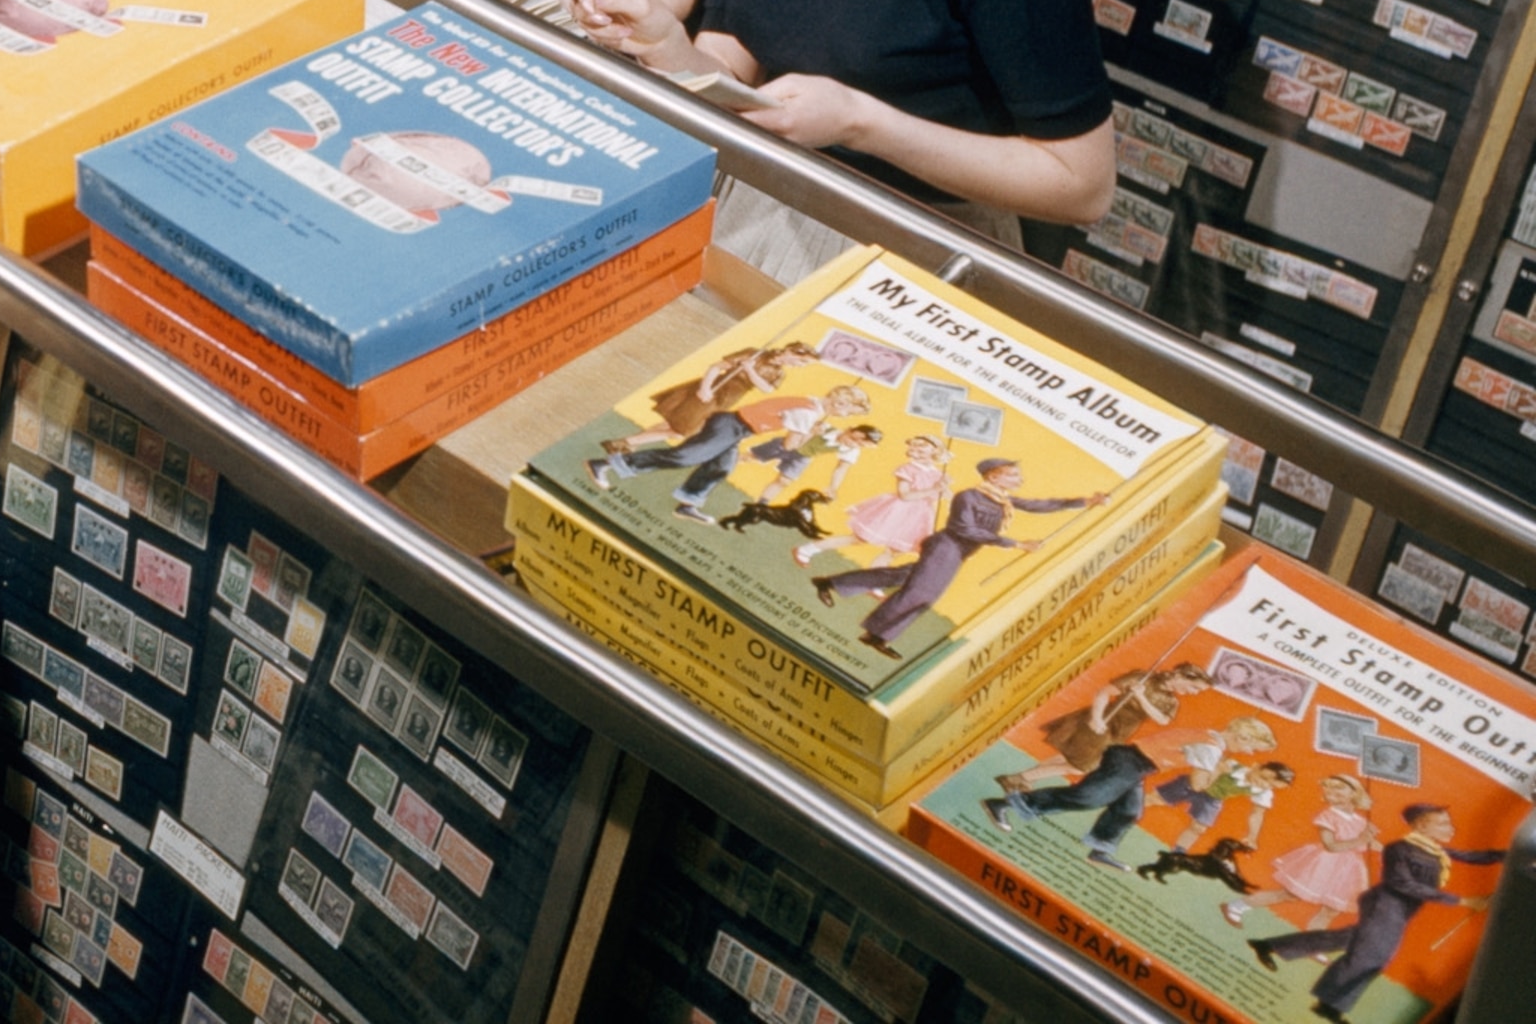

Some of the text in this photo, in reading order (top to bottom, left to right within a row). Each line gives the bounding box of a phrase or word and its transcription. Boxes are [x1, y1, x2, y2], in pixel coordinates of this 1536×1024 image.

[307, 52, 403, 104] OUTFIT
[346, 36, 585, 167] STAMP COLLECTOR'S
[387, 19, 659, 171] The New INTERNATIONAL
[449, 209, 638, 317] STAMP COLLECTOR'S OUTFIT
[464, 247, 642, 357] FIRST STAMP OUTFIT
[145, 312, 323, 438] FIRST STAMP OUTFIT
[447, 300, 619, 410] FIRST STAMP OUTFIT
[846, 296, 1137, 460] THE IDEAL ALBUM FOR THE BEGINNING COLLECTOR
[869, 277, 1162, 445] My First Stamp Album
[547, 512, 836, 703] MY FIRST STAMP OUTFIT
[776, 595, 812, 621] 2500
[965, 539, 1169, 716] MY FIRST STAMP OUTFIT
[966, 495, 1169, 677] MY FIRST STAMP OUTFIT
[686, 629, 709, 650] Flags
[734, 658, 761, 683] Coats
[764, 678, 775, 691] of
[779, 688, 804, 710] Arms
[830, 717, 864, 746] Hinges
[826, 640, 870, 670] COUNTRY
[1249, 598, 1536, 765] First Stamp Out
[1257, 632, 1529, 783] A COMPLETE OUTFIT FOR THE BEGINNER
[1346, 631, 1504, 718] DELUXE EDITION
[685, 665, 709, 689] Flags
[733, 696, 759, 722] Coats
[762, 719, 773, 730] of
[776, 726, 800, 749] Arms
[825, 755, 859, 785] Hinges
[72, 802, 94, 824] HAITI
[162, 818, 233, 879] HAITI PACKETS
[981, 863, 1228, 1024] FIRST STAMP OUT
